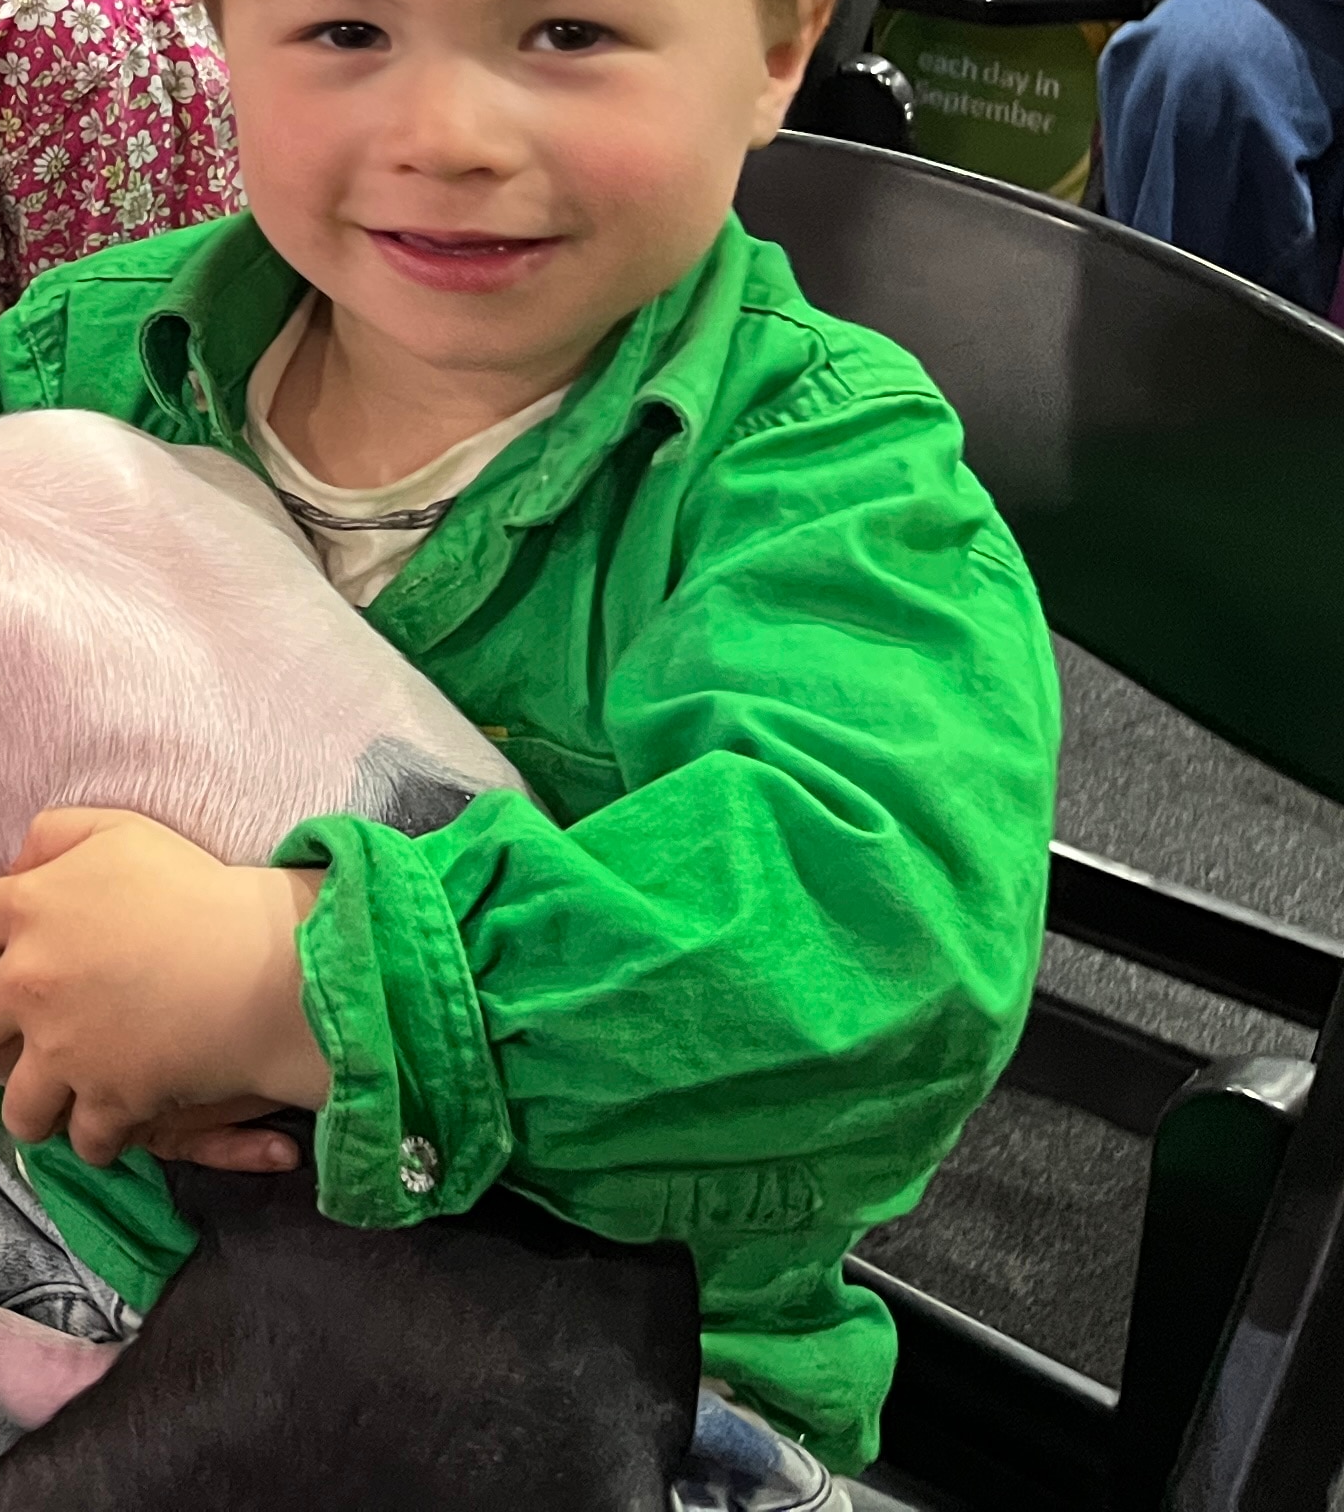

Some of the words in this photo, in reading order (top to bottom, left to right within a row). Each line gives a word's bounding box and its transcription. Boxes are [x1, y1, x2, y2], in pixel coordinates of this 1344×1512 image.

[917, 51, 979, 82] each
[982, 60, 1030, 98] day
[1034, 69, 1060, 100] in
[914, 79, 1057, 136] September
